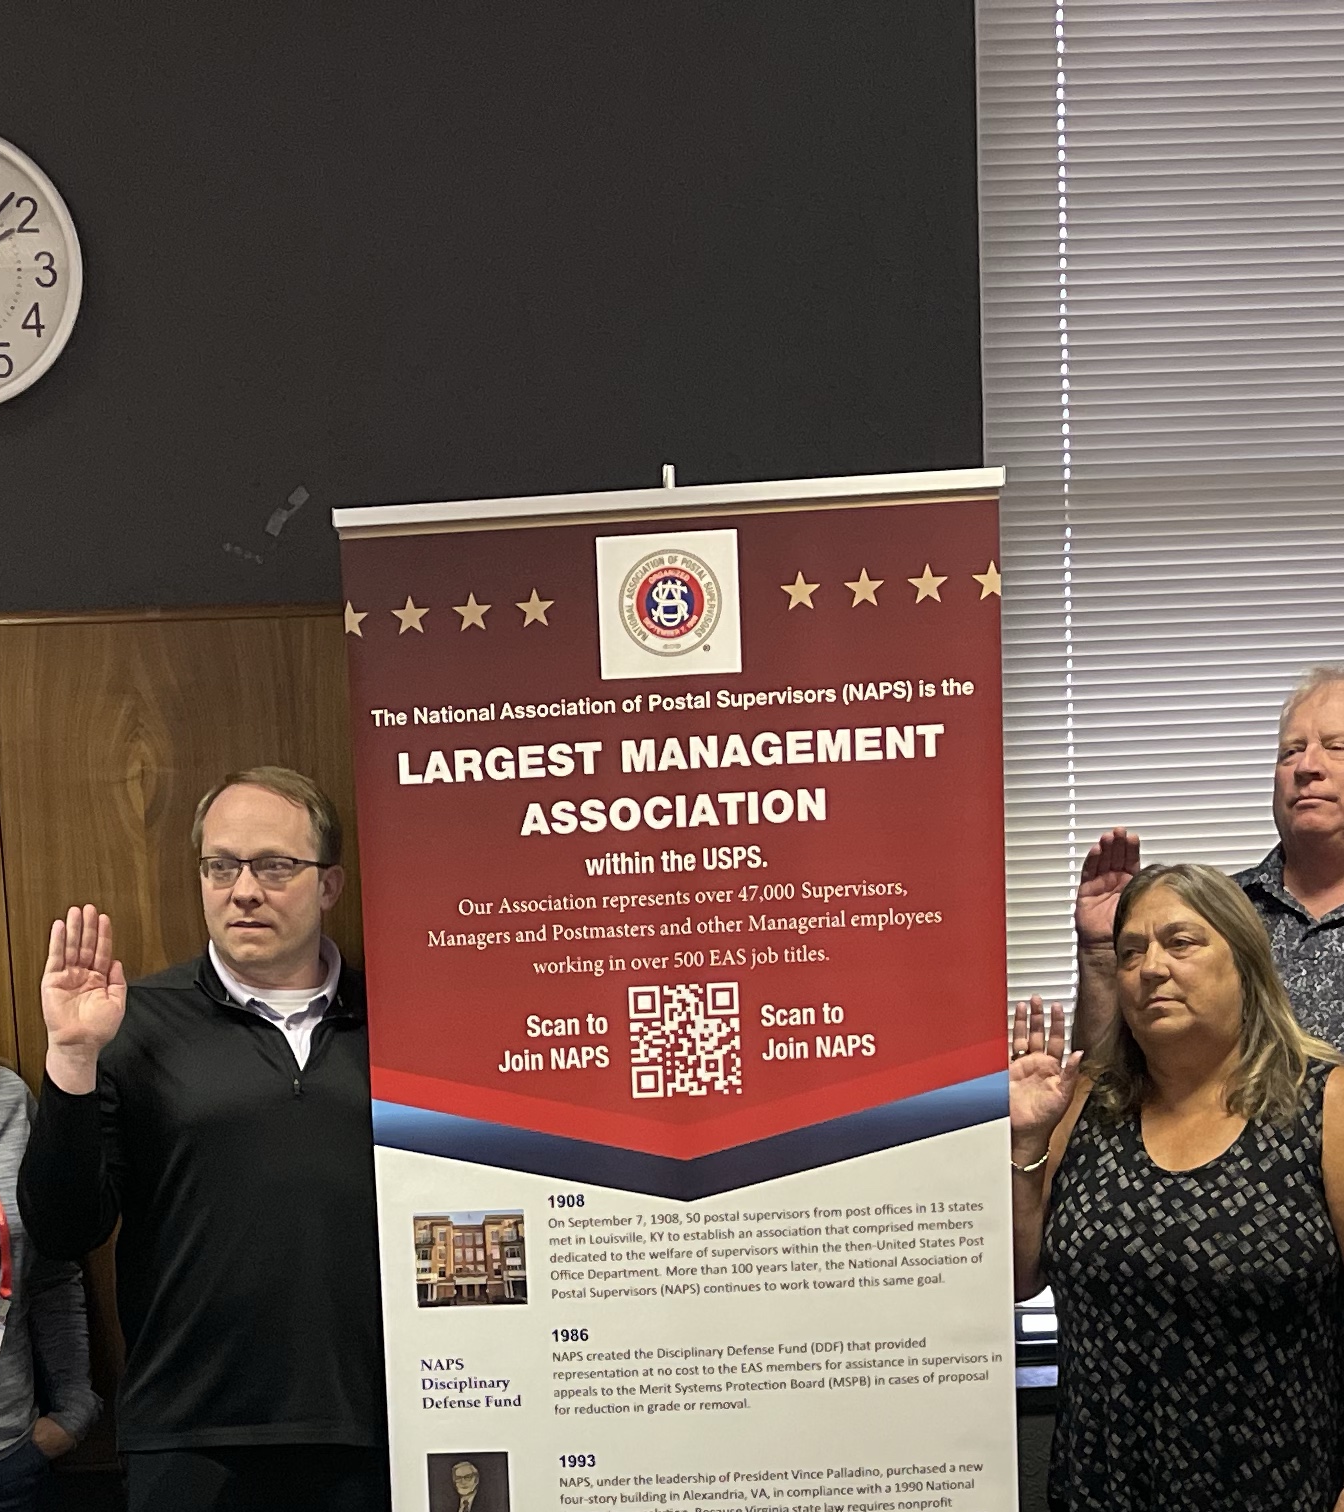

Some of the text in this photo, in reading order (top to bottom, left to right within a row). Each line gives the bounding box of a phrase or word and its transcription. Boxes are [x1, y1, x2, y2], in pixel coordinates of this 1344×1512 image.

[16, 196, 39, 233] 2
[34, 251, 57, 288] 3
[21, 302, 45, 338] 4
[667, 555, 678, 565] OF
[681, 557, 708, 581] POSTAL
[625, 556, 665, 599] ASSOCIATION
[625, 603, 649, 642] NATIONAL
[695, 581, 716, 639] SUPERVISORS
[370, 677, 974, 727] The National Association of Postal Supervisors (NAPS) is the
[398, 723, 944, 785] LARGEST MANAGEMENT
[520, 788, 826, 836] ASSOCIATION
[584, 845, 768, 876] within the USPS.
[458, 879, 908, 916] Our Association represents over 47,000 Supervisors,
[427, 907, 942, 950] Managers and Postmasters and other Managerial employees
[532, 944, 830, 977] working in over 500 EAS job titles.
[526, 1013, 608, 1038] Scan to
[760, 1002, 844, 1027] Scan to
[498, 1045, 610, 1072] Join NAPS
[761, 1033, 876, 1061] Join NAPS
[547, 1193, 585, 1208] 1908
[547, 1217, 565, 1229] On
[567, 1214, 633, 1230] September
[685, 1212, 701, 1224] 50
[703, 1210, 740, 1225] postal
[742, 1209, 811, 1223] supervisors
[812, 1206, 842, 1218] from
[844, 1205, 871, 1219] post
[874, 1203, 913, 1215] offices
[915, 1204, 927, 1213] in
[930, 1201, 945, 1213] 13
[947, 1201, 984, 1212] states
[548, 1235, 573, 1246] met
[574, 1235, 586, 1245] in
[649, 1230, 665, 1242] KY
[666, 1231, 680, 1242] to
[682, 1227, 735, 1241] establish
[737, 1229, 753, 1239] an
[755, 1225, 822, 1238] association
[824, 1223, 850, 1235] that
[852, 1220, 914, 1235] comprised
[916, 1218, 974, 1231] members
[551, 1327, 589, 1342] 1986
[551, 1336, 927, 1362] NAPS created the Disciplinary Defense Fund (DDF) that provided
[420, 1357, 465, 1371] NAPS
[420, 1376, 511, 1393] Disciplinary
[421, 1394, 522, 1409] Defense Fund
[558, 1453, 596, 1468] 1993
